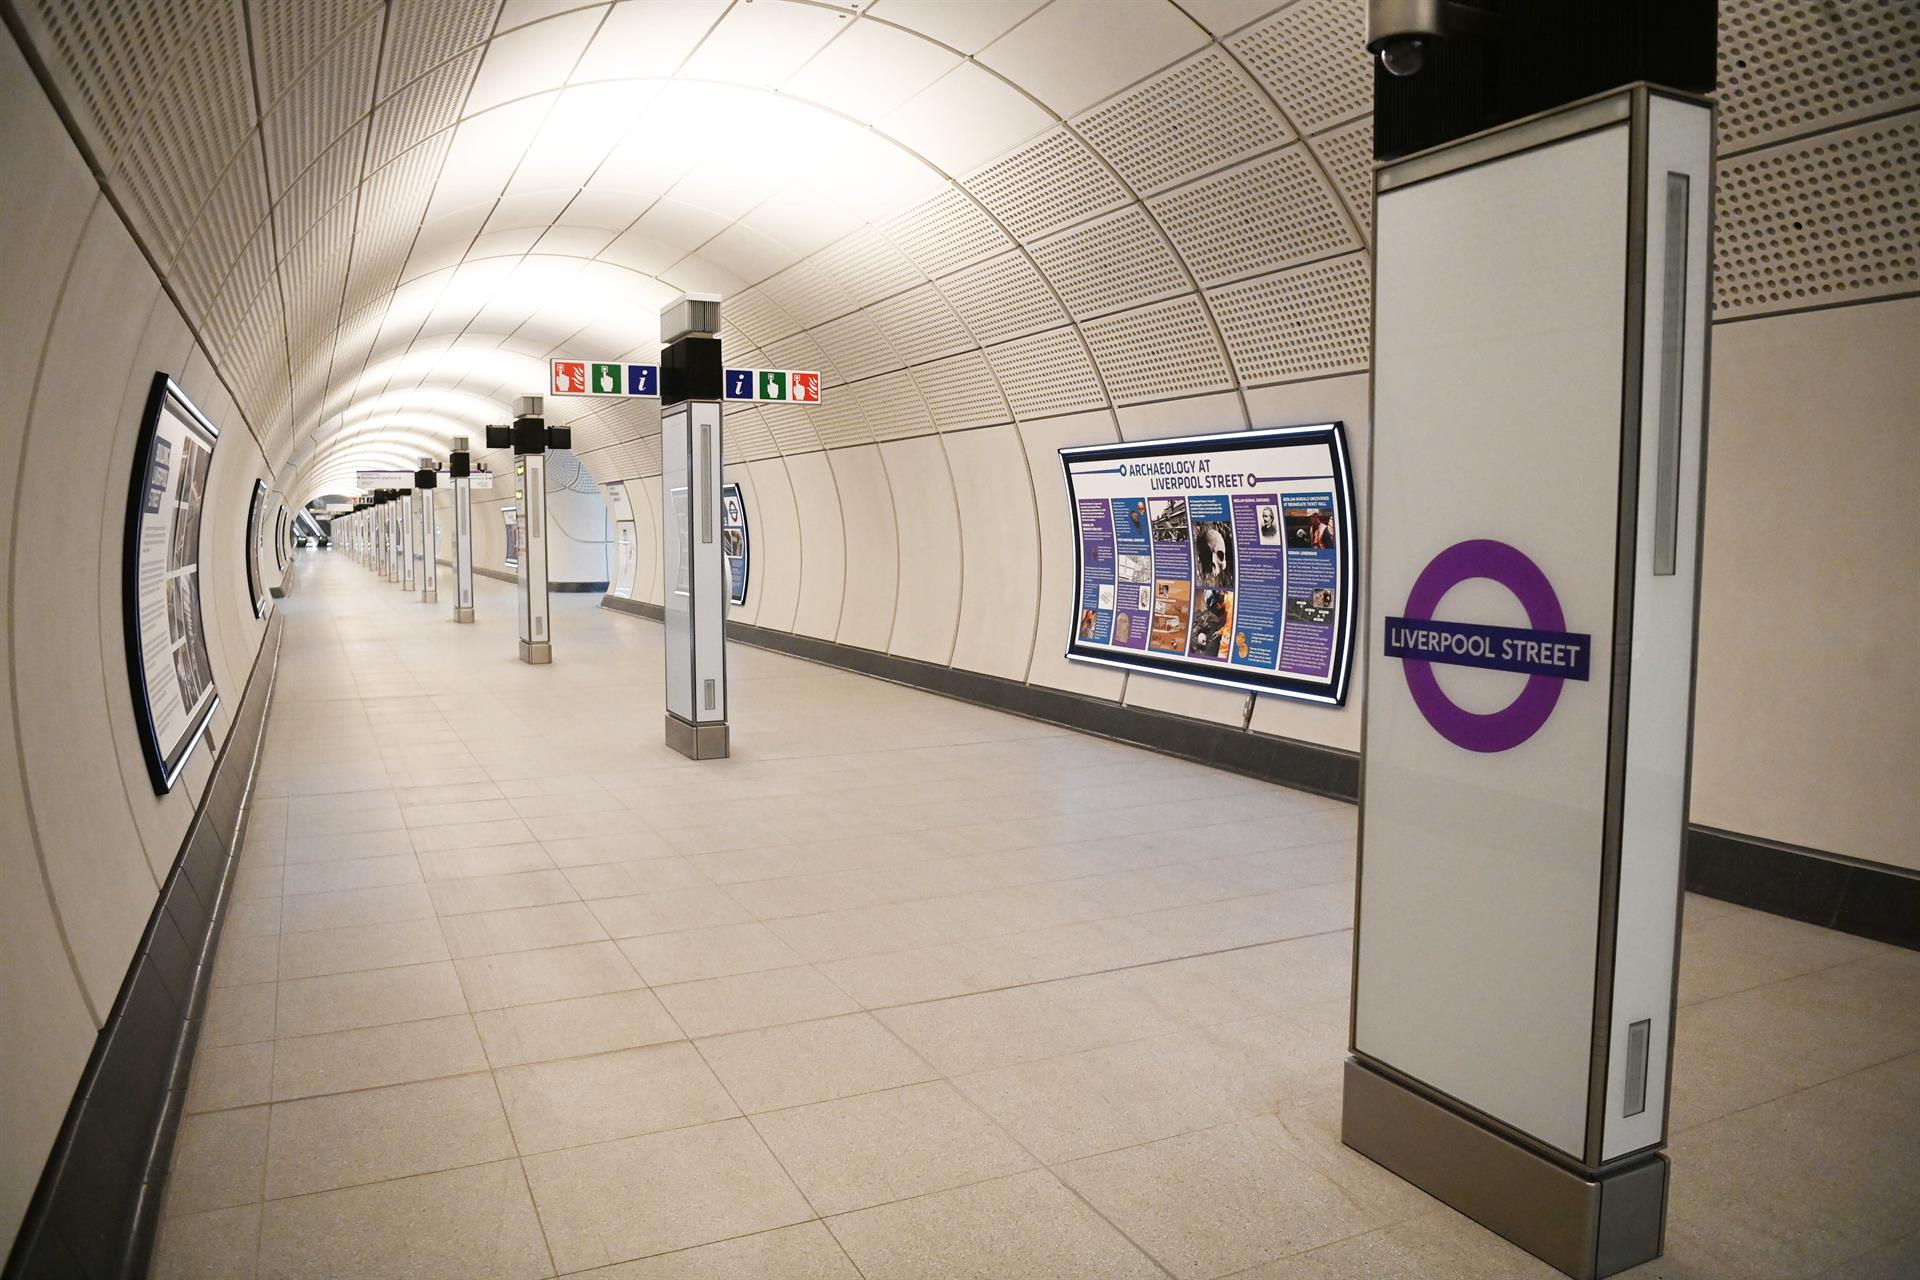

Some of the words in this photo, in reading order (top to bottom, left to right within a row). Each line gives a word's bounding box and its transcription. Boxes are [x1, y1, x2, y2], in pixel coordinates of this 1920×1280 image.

[1129, 460, 1196, 477] ARCHAEOLOGY
[1198, 459, 1211, 473] AT
[1150, 475, 1204, 490] LIVERPOOL
[1204, 473, 1244, 488] STREET
[1391, 627, 1495, 658] LIVERPOOL
[1501, 638, 1581, 667] STREET
